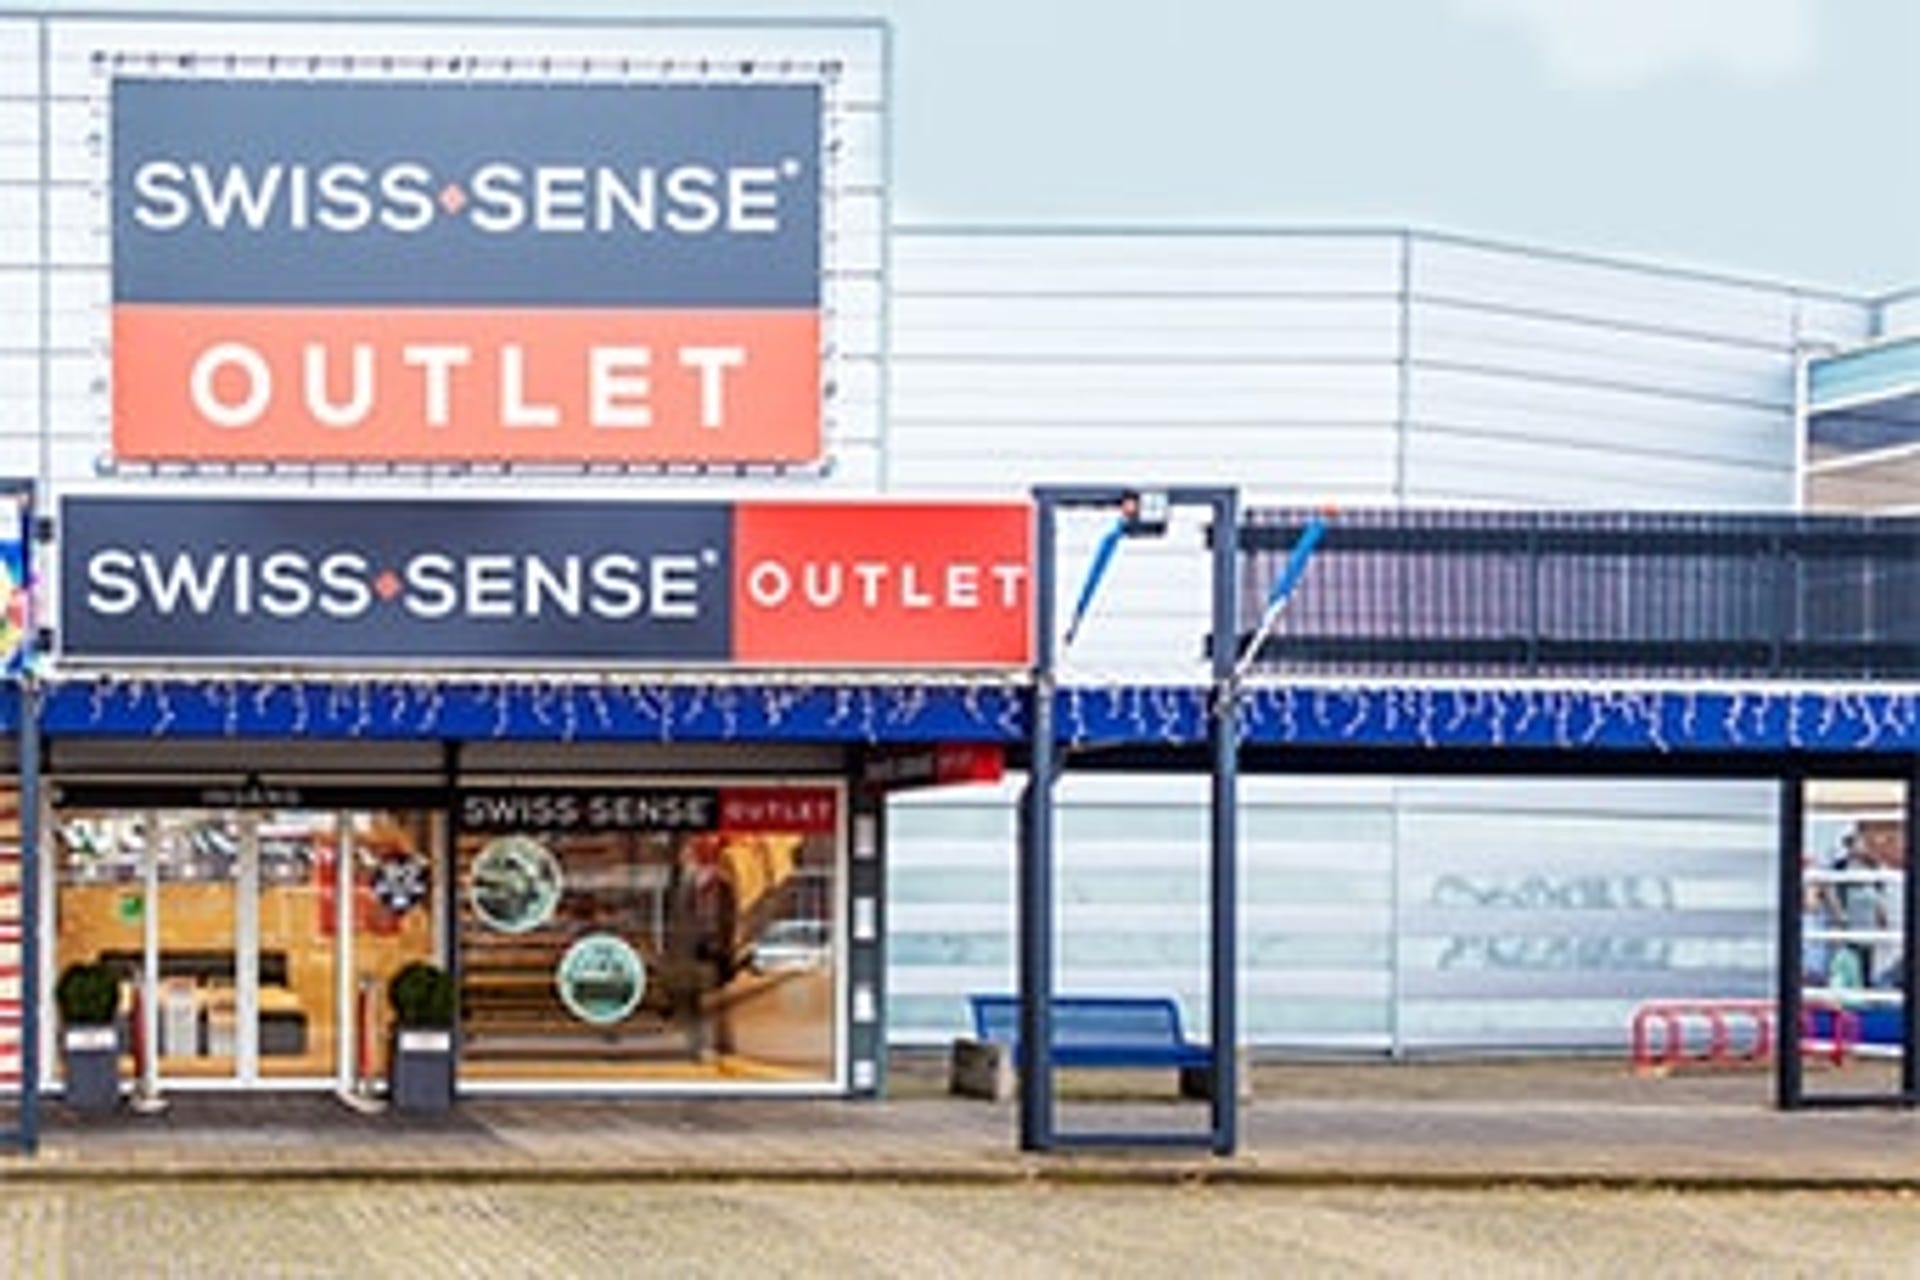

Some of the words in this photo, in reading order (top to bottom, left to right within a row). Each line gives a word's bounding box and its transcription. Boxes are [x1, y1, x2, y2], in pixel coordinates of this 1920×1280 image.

[133, 161, 435, 232] SWISS
[471, 161, 779, 233] SENSE
[189, 342, 747, 429] OUTLET
[87, 552, 372, 616] SWISS
[404, 552, 699, 618] SENSE
[748, 561, 1027, 608] OUTLET
[464, 796, 579, 825] SWISS
[589, 796, 710, 826] SENSE
[723, 800, 832, 823] OUTLET
